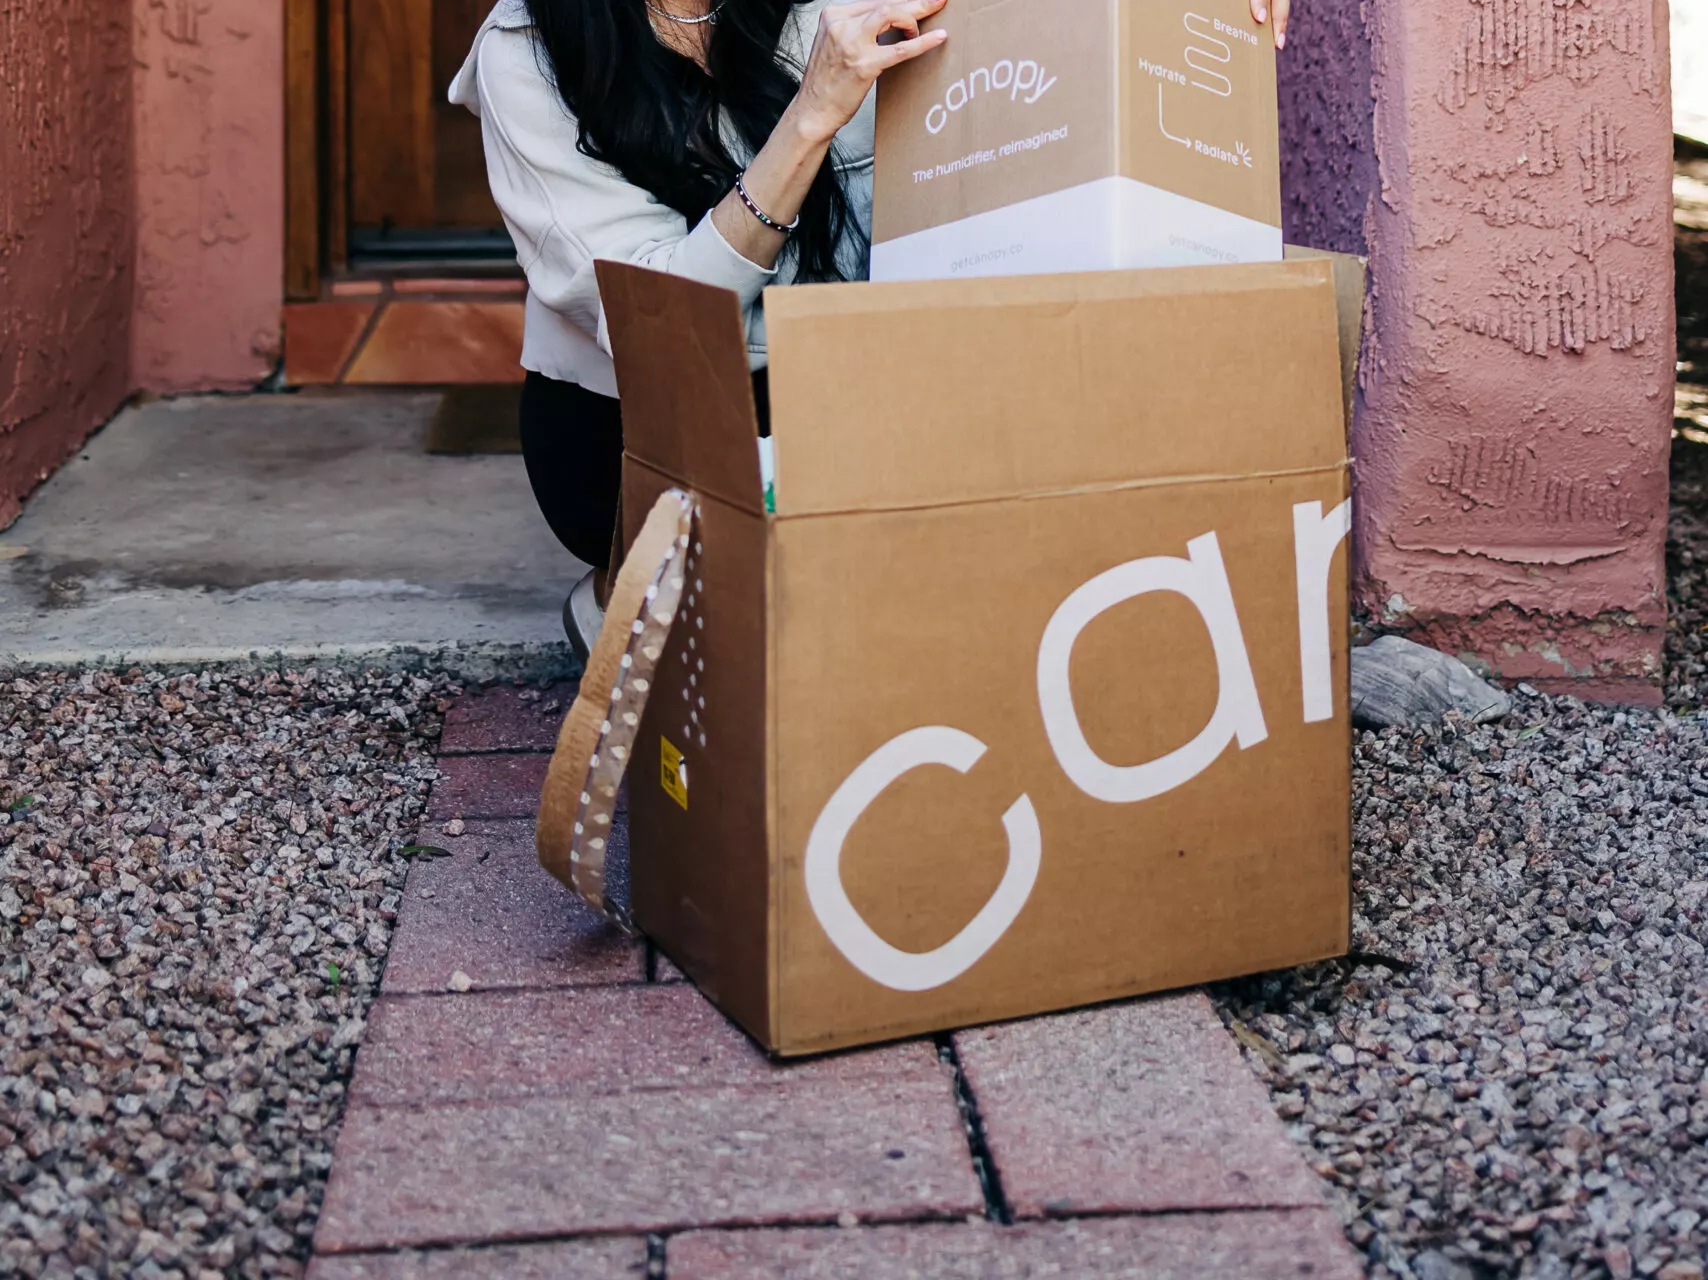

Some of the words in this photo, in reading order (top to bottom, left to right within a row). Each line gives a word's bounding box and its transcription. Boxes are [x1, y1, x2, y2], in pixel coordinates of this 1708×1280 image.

[1213, 18, 1258, 45] Breathe
[1138, 57, 1187, 85] Hydrate
[925, 59, 1058, 134] canopy
[912, 169, 934, 183] The
[935, 147, 996, 177] humidifier,
[998, 124, 1068, 158] reimagined
[1194, 140, 1239, 165] Radiate
